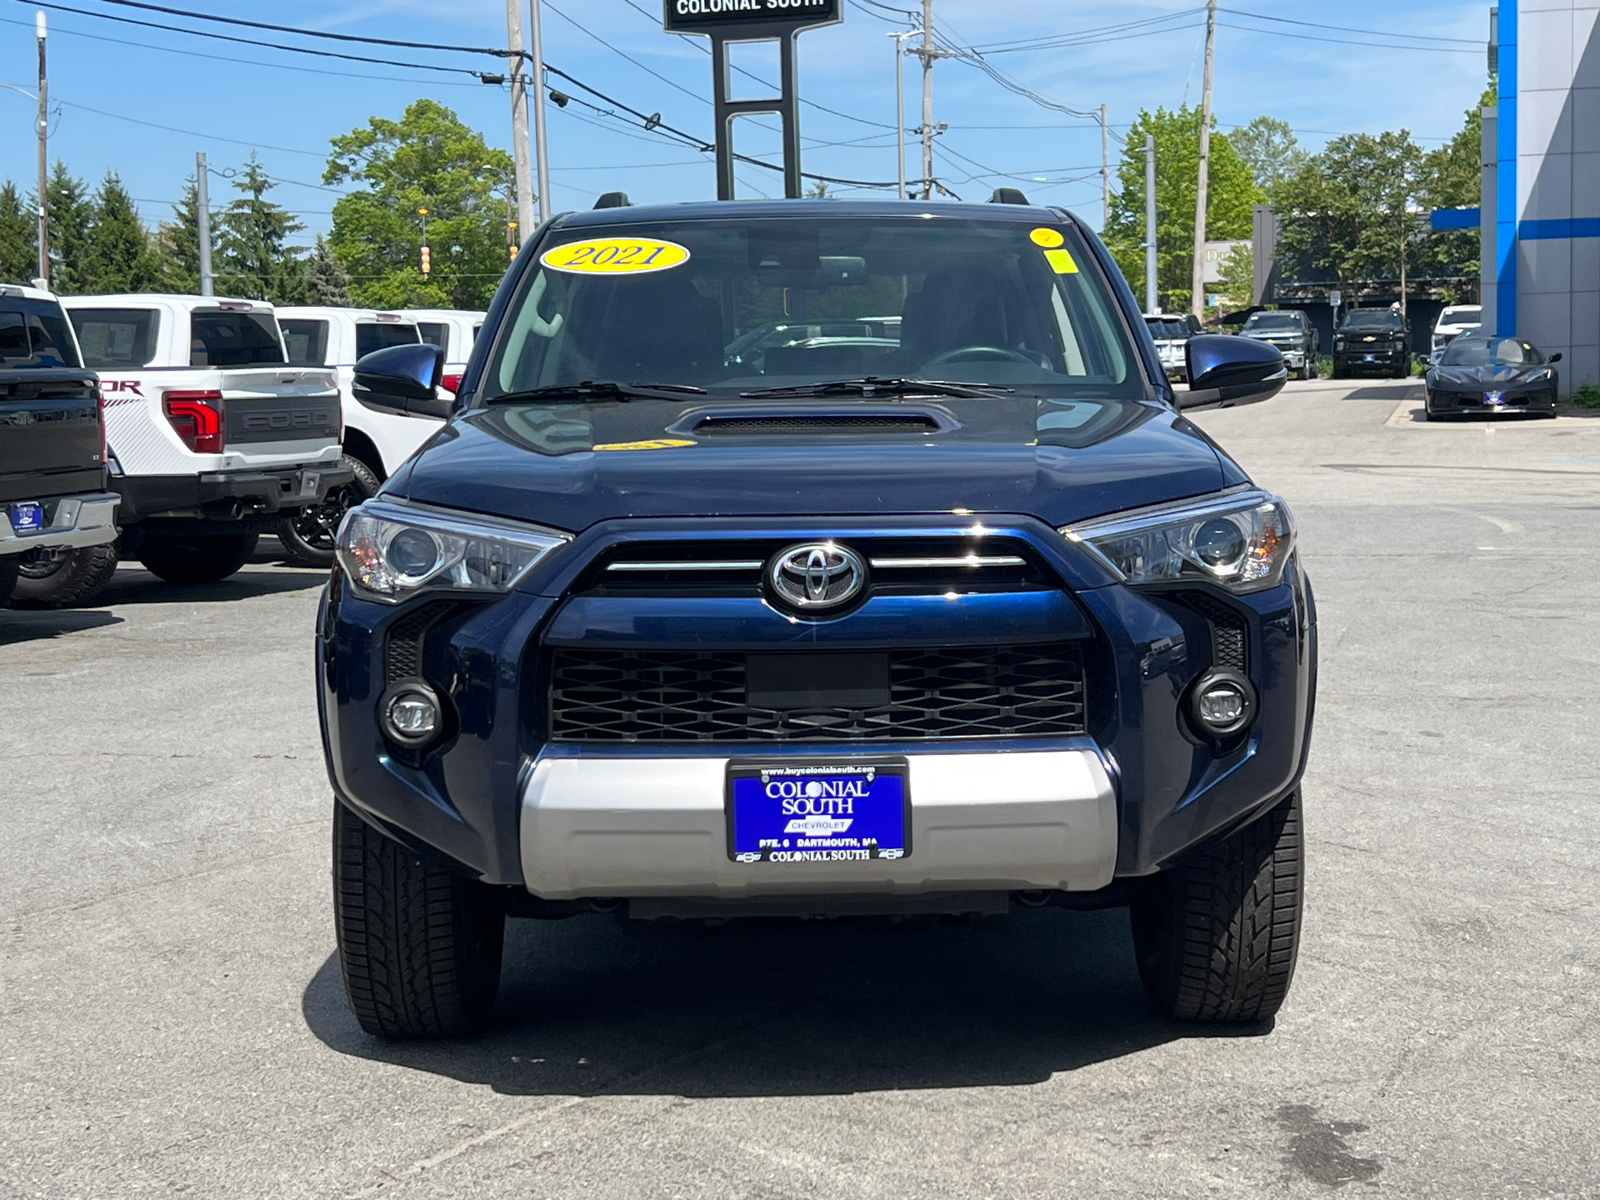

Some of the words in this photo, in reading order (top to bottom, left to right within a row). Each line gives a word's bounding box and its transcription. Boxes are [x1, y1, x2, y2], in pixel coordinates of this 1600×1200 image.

[676, 0, 761, 15] COLONIAL
[564, 245, 666, 266] 2021
[242, 410, 331, 430] FORD
[761, 766, 876, 777] www.buycolonialsouth.com
[766, 781, 870, 798] COLONIAL
[782, 798, 854, 815] SOUTH
[791, 821, 846, 830] CHEVROLET
[782, 839, 790, 848] 6
[797, 838, 861, 848] DARTMOUTH,
[769, 850, 831, 862] COLONIAL
[831, 849, 870, 861] SOUTH
